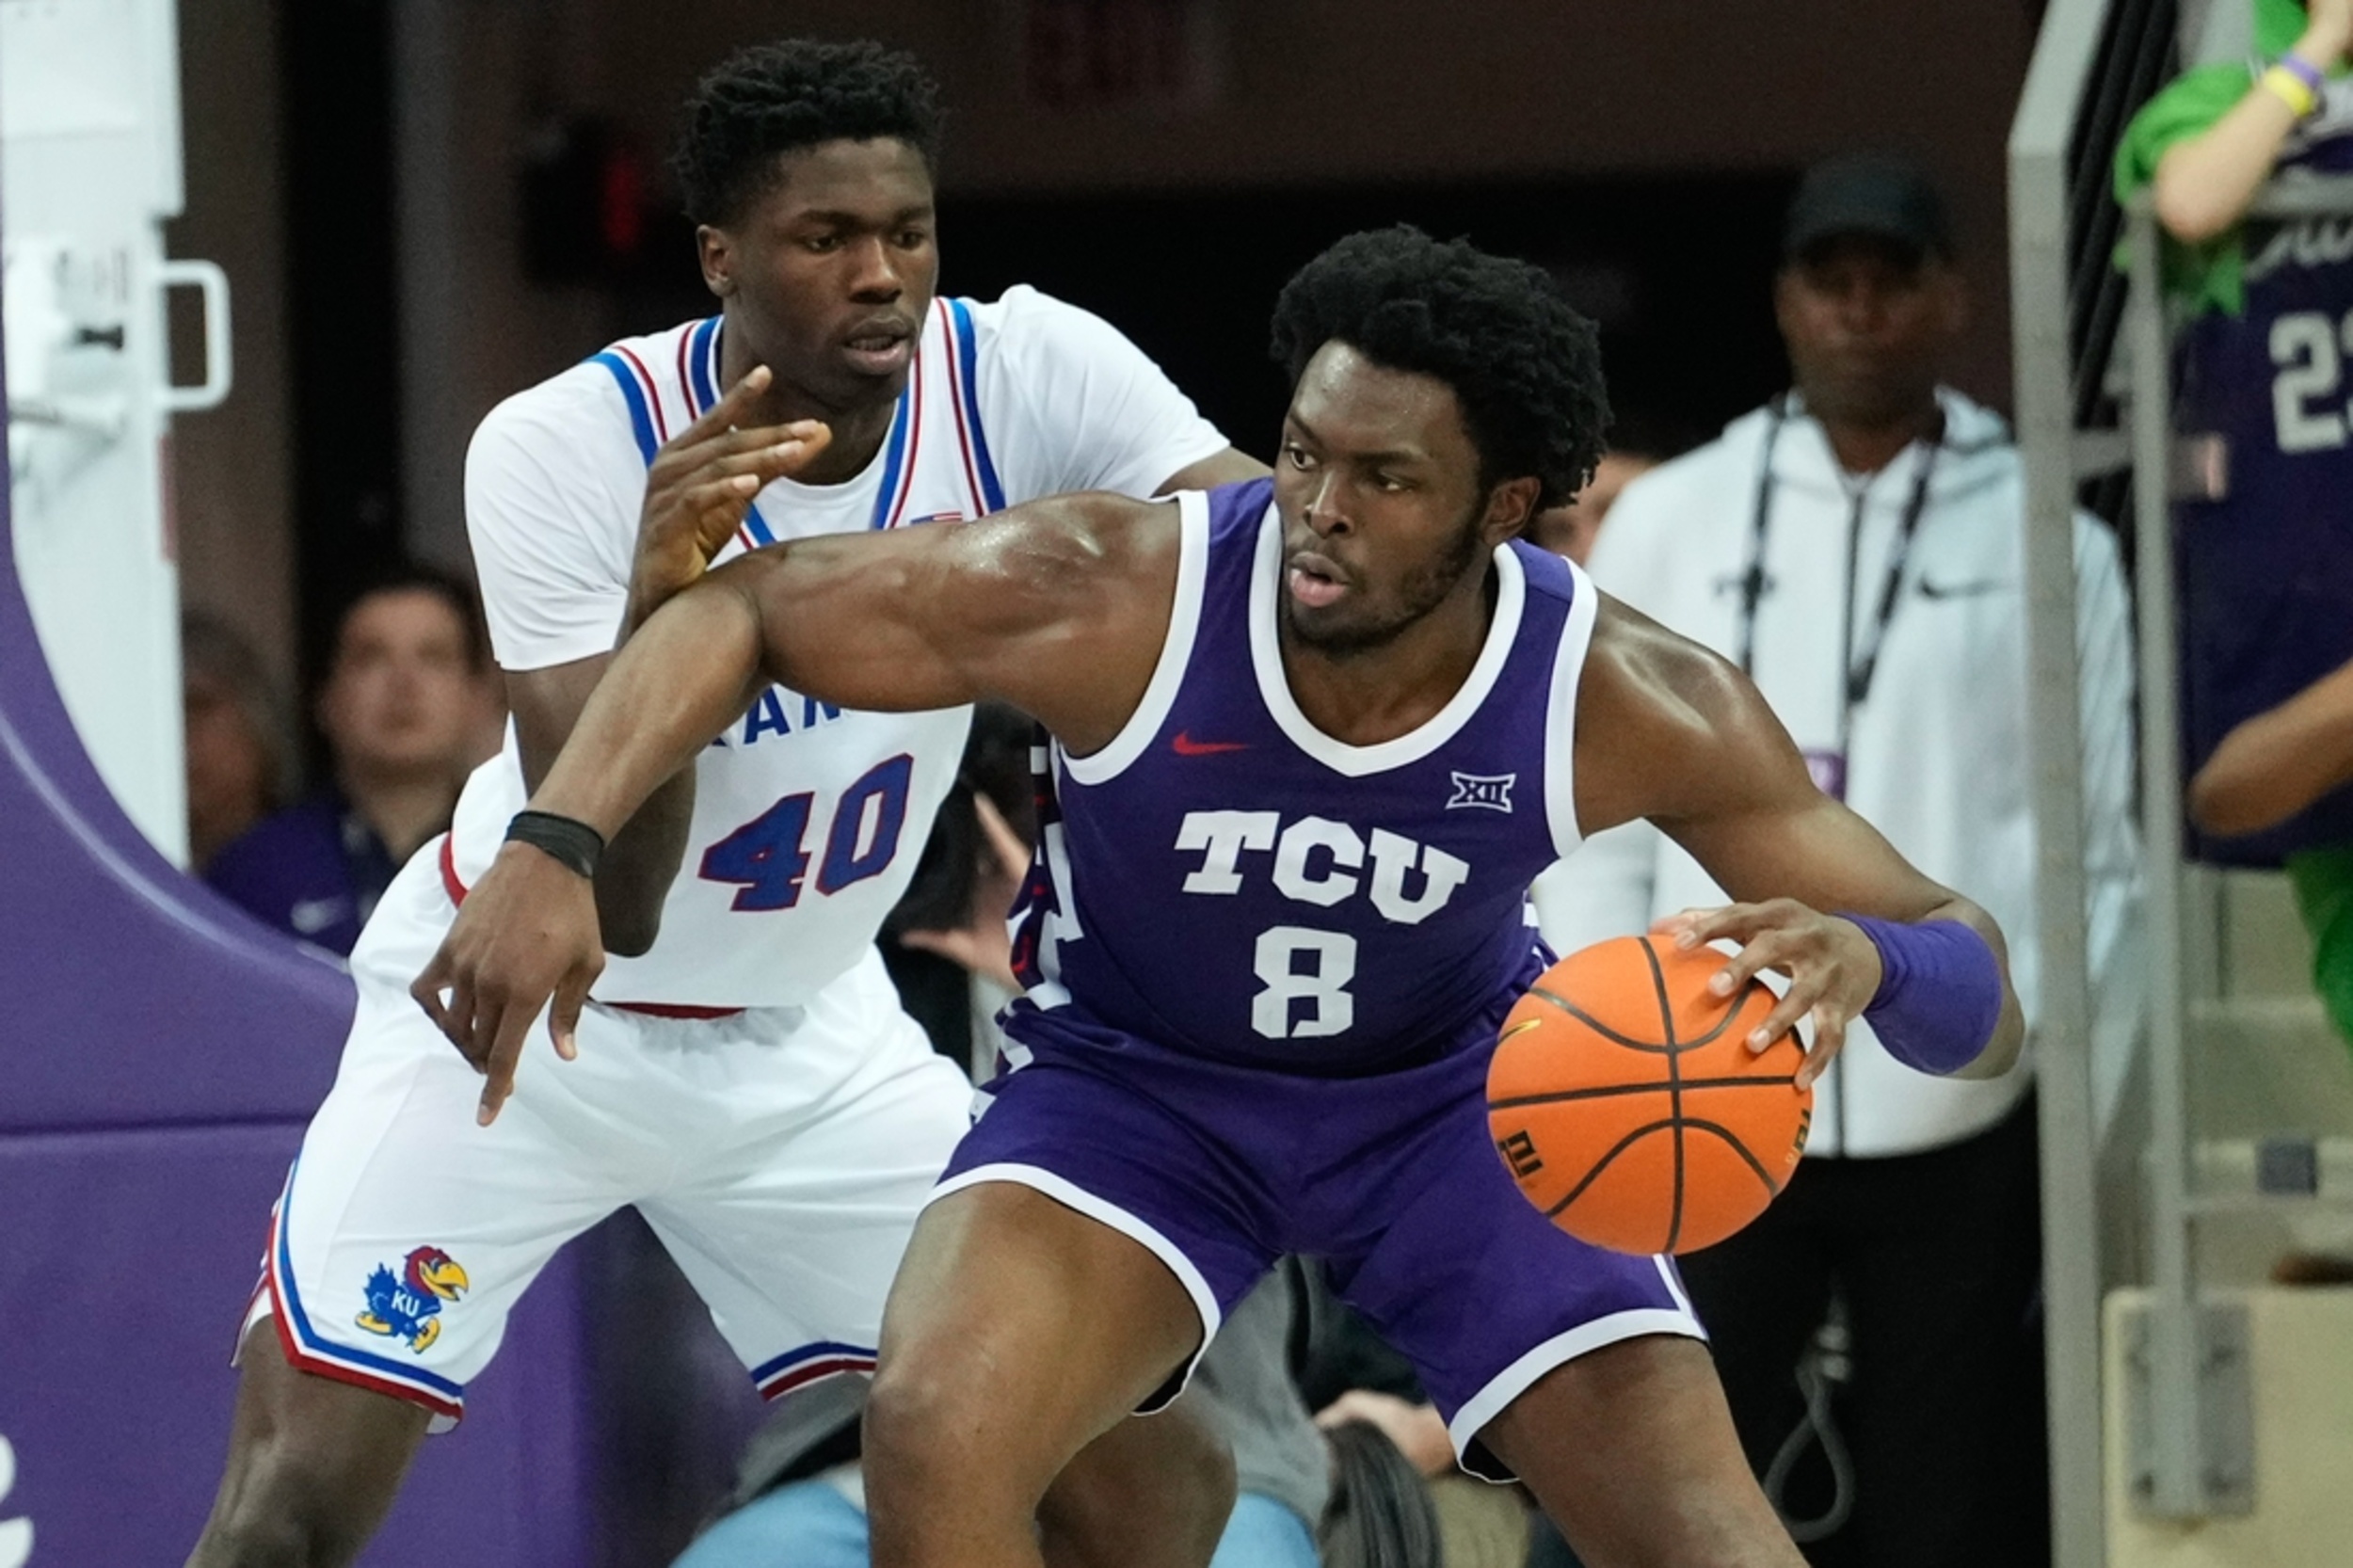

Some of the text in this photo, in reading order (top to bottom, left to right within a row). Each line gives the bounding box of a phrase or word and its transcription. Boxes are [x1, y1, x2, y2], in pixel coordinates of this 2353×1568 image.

[2268, 310, 2353, 455] 2
[697, 752, 914, 912] 40
[1174, 810, 1470, 925] TCU
[1251, 925, 1357, 1039] 8
[391, 1289, 421, 1318] KU
